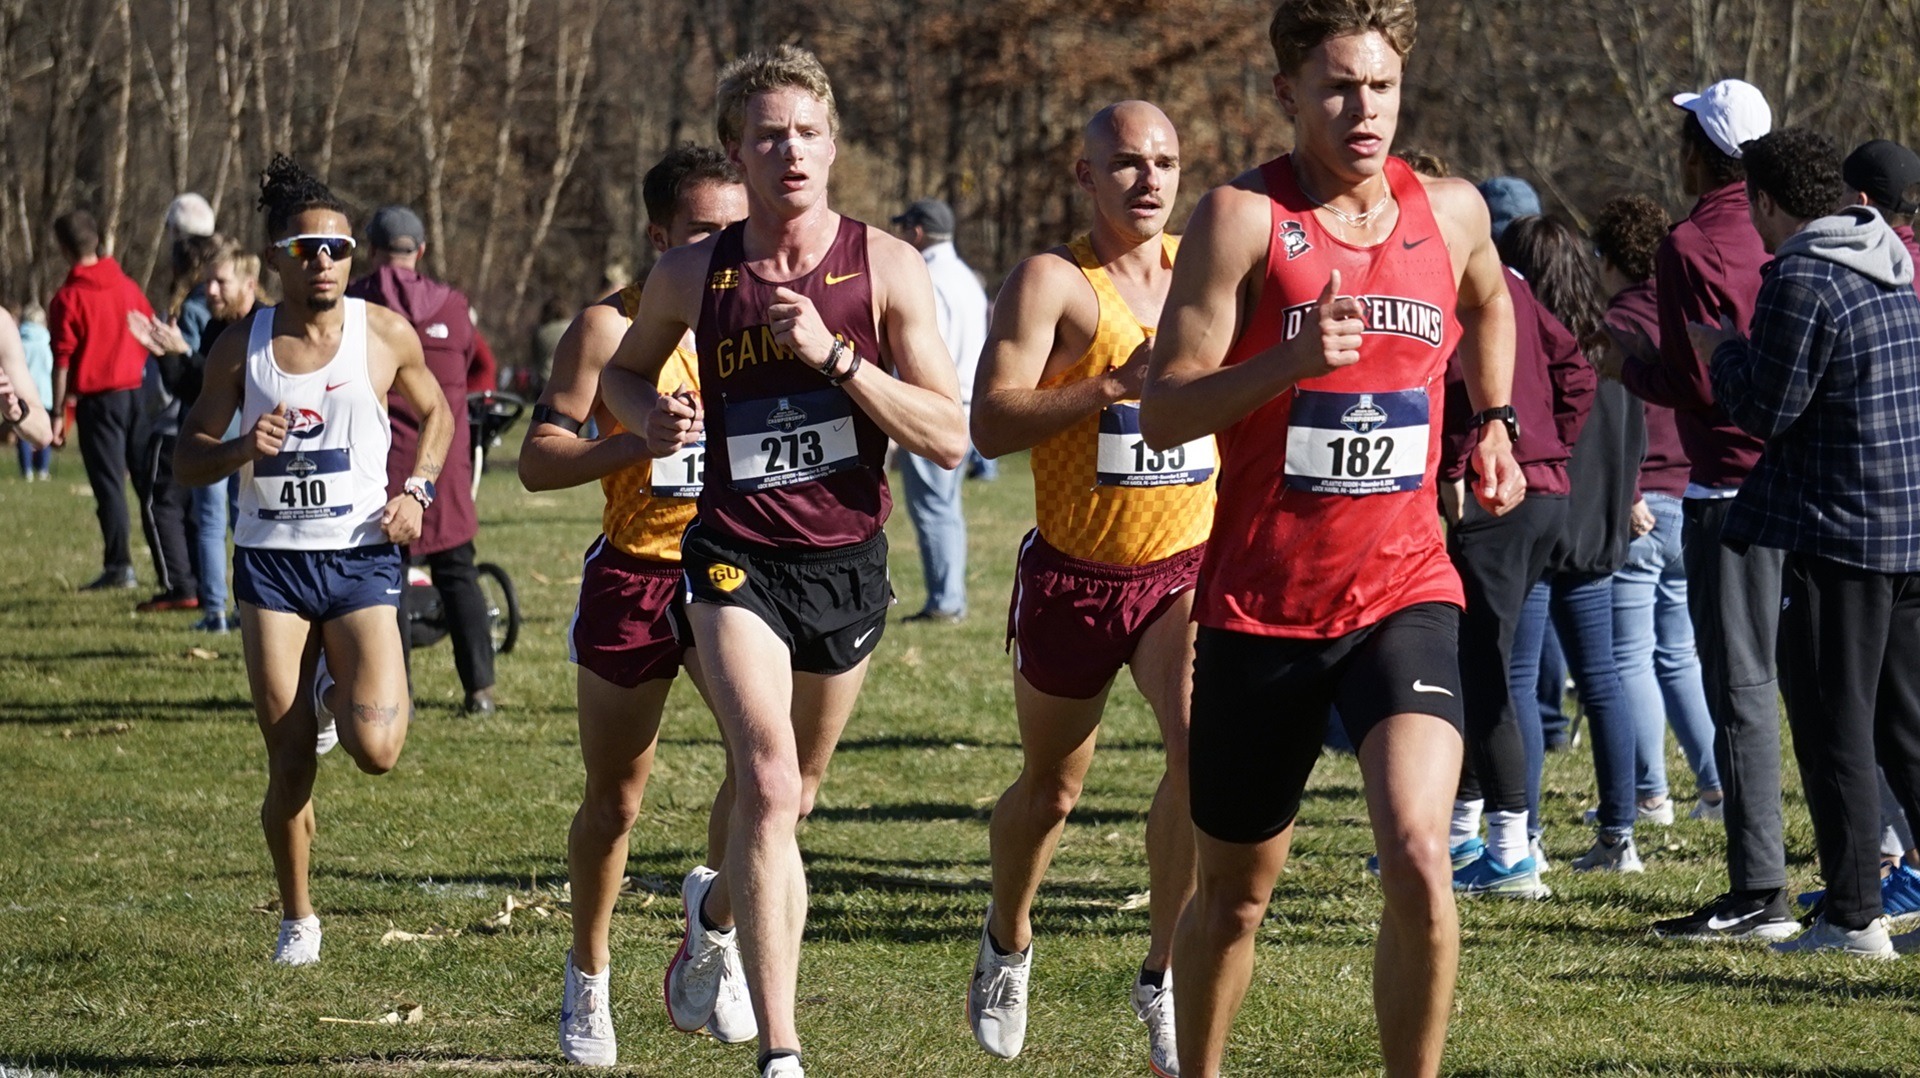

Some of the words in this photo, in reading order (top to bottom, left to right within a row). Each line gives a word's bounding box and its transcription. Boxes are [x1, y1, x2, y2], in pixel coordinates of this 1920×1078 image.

[1372, 299, 1442, 344] ELKINS
[761, 430, 824, 474] 273
[1326, 436, 1395, 478] 182
[280, 479, 327, 508] 410
[713, 567, 740, 583] GU
